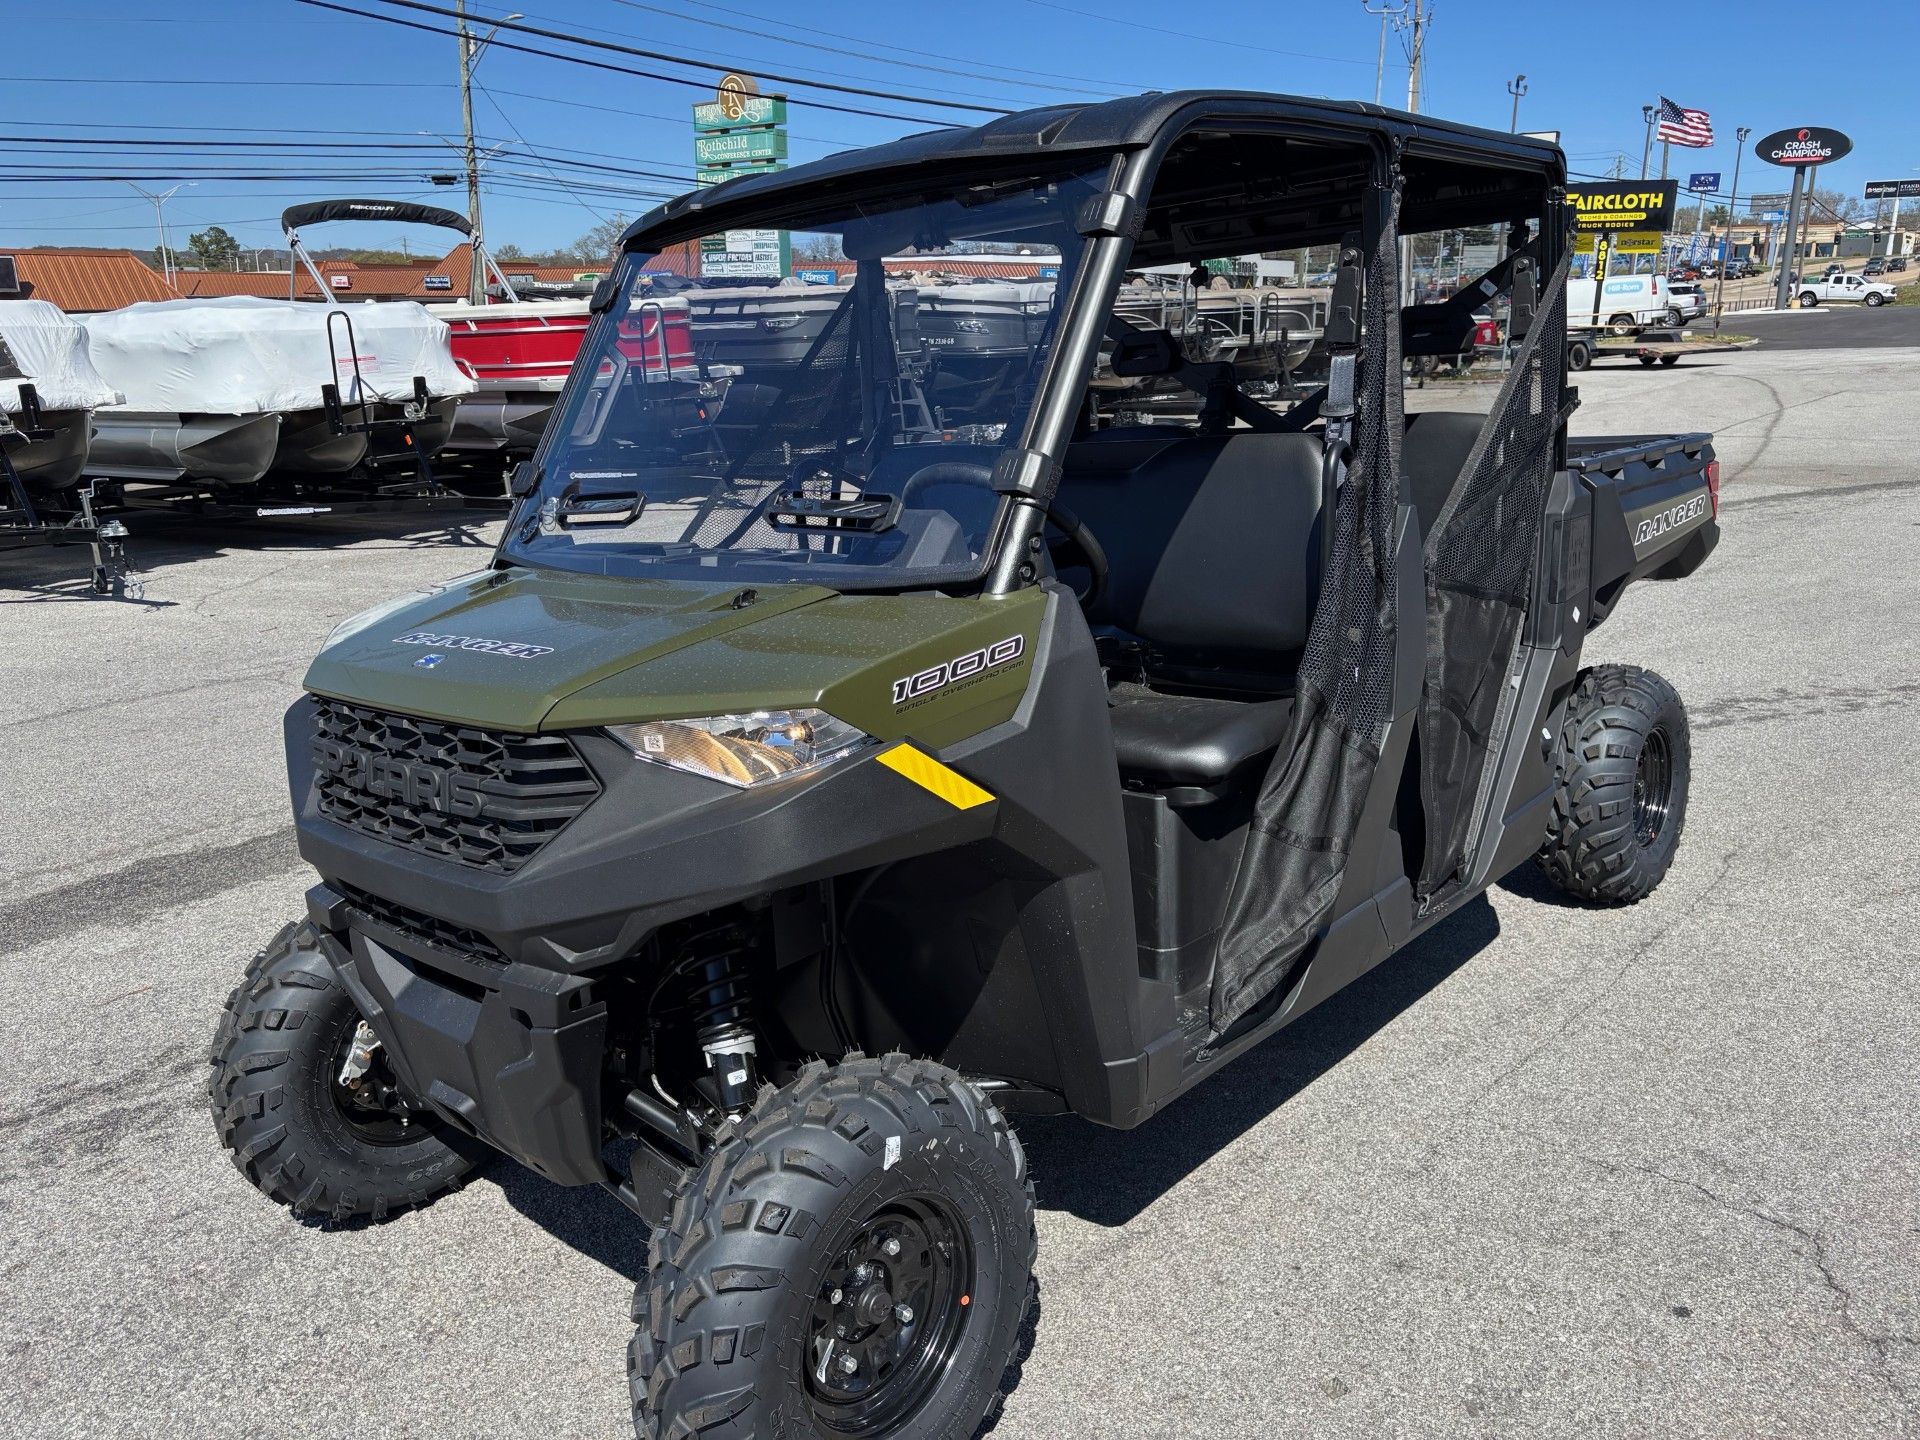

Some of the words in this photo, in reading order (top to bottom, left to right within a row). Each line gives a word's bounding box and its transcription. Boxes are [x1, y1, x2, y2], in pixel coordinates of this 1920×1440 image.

[699, 135, 748, 154] Rothchild
[1785, 140, 1821, 150] CRASH
[717, 150, 751, 160] CONFERENCE
[751, 148, 772, 157] CENTER
[1771, 147, 1832, 159] CHAMPIONS
[698, 171, 728, 184] Event
[1566, 192, 1664, 211] FAIRCLOTH
[1609, 212, 1644, 220] COATINGS
[532, 281, 574, 291] Ranger
[1607, 283, 1640, 293] Hill-Rom
[1634, 493, 1706, 546] RANGER
[392, 632, 554, 659] RANGER
[892, 633, 1026, 705] 1000
[895, 693, 940, 715] SINGLE
[941, 669, 1001, 698] OVERHEAD
[1000, 660, 1025, 674] CAM
[318, 738, 487, 819] POLARIS
